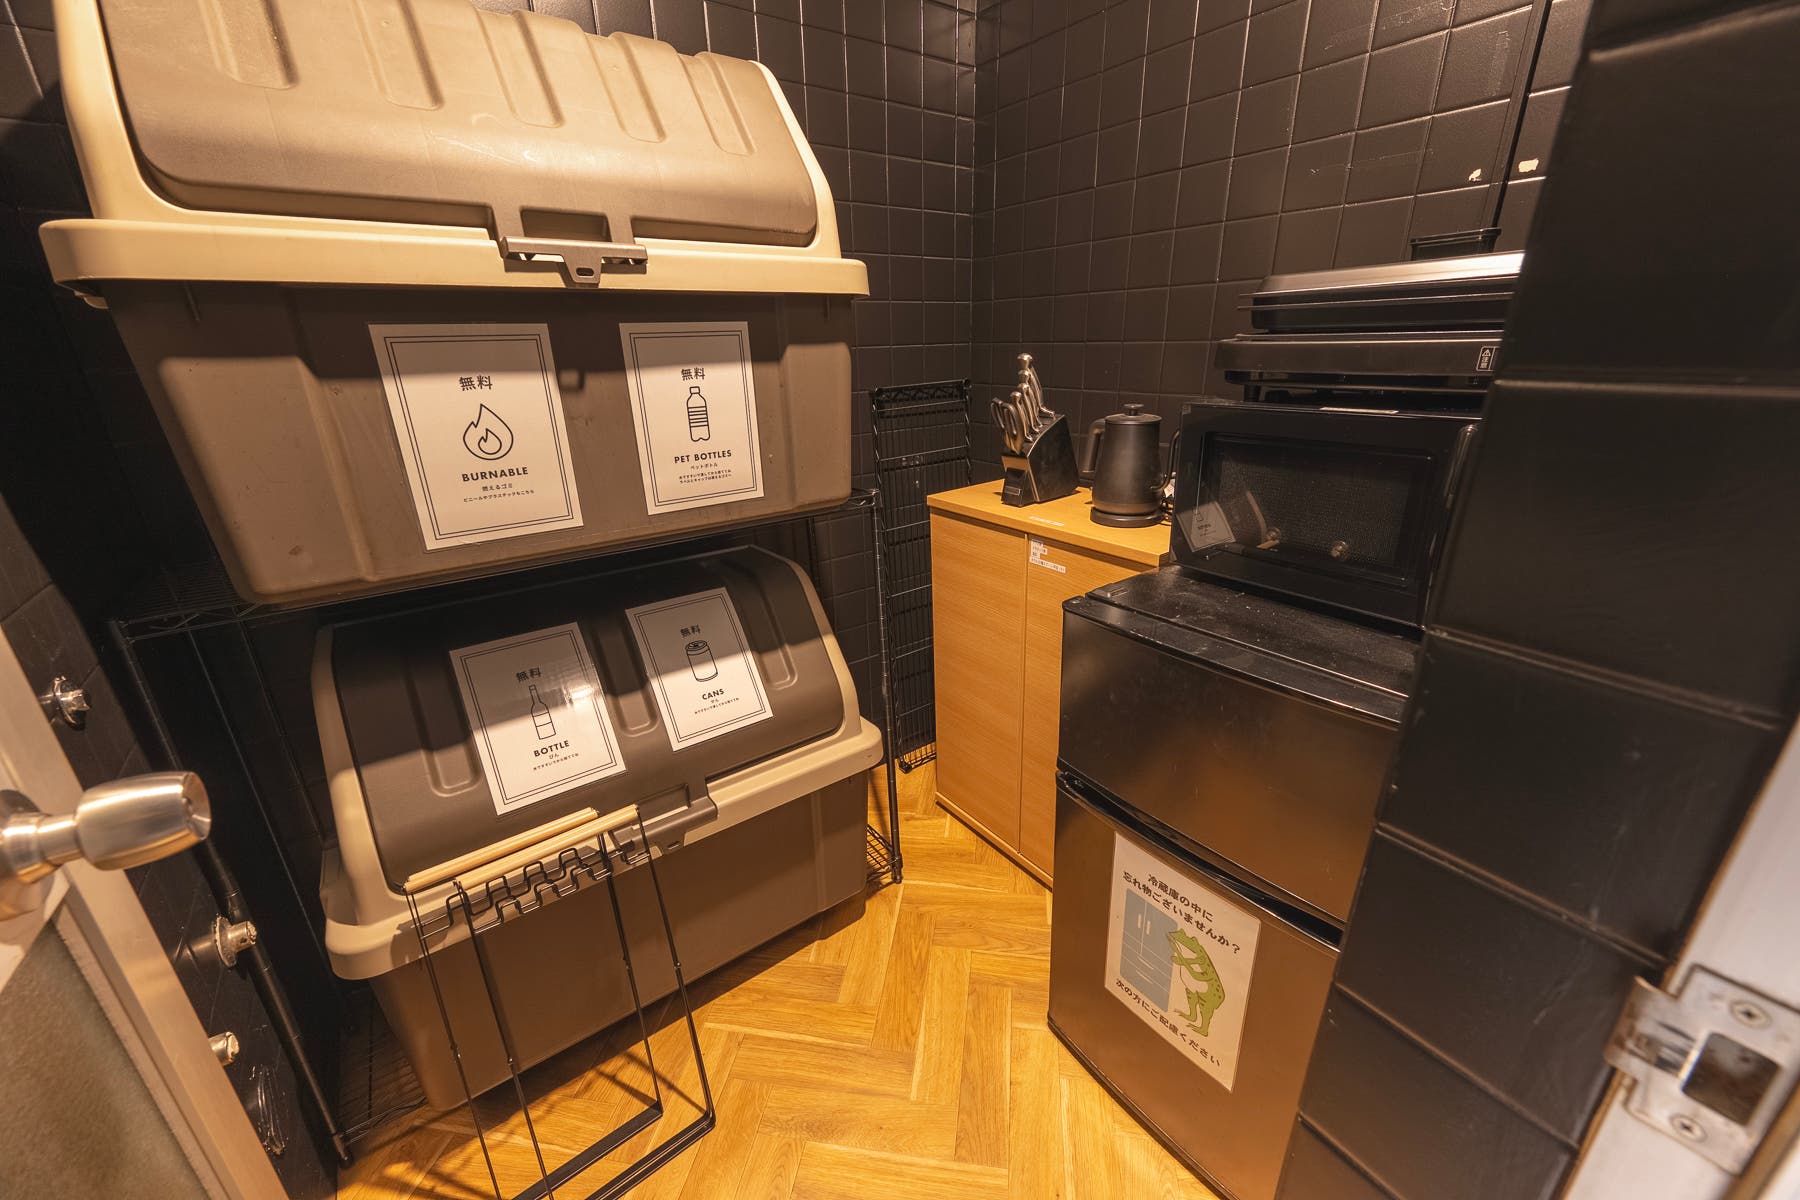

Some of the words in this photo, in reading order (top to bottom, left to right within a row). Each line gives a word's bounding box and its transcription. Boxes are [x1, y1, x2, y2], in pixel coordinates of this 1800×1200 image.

[680, 367, 706, 381] 無料
[459, 375, 493, 391] 無料
[674, 455, 691, 464] PET
[694, 449, 732, 462] BOTTLES
[690, 462, 719, 470] ペットボトル
[461, 467, 528, 482] BURNABLE
[482, 483, 513, 492] 燃えるゴミ
[680, 624, 701, 638] 無料
[516, 667, 542, 682] 無料
[701, 688, 725, 700] CANS
[533, 740, 570, 757] BOTTLE
[1148, 873, 1214, 923] 冷蔵庫の中に
[1123, 871, 1241, 954] 忘れ物ございませんか？
[1115, 978, 1221, 1067] 次の方にご配慮ください
